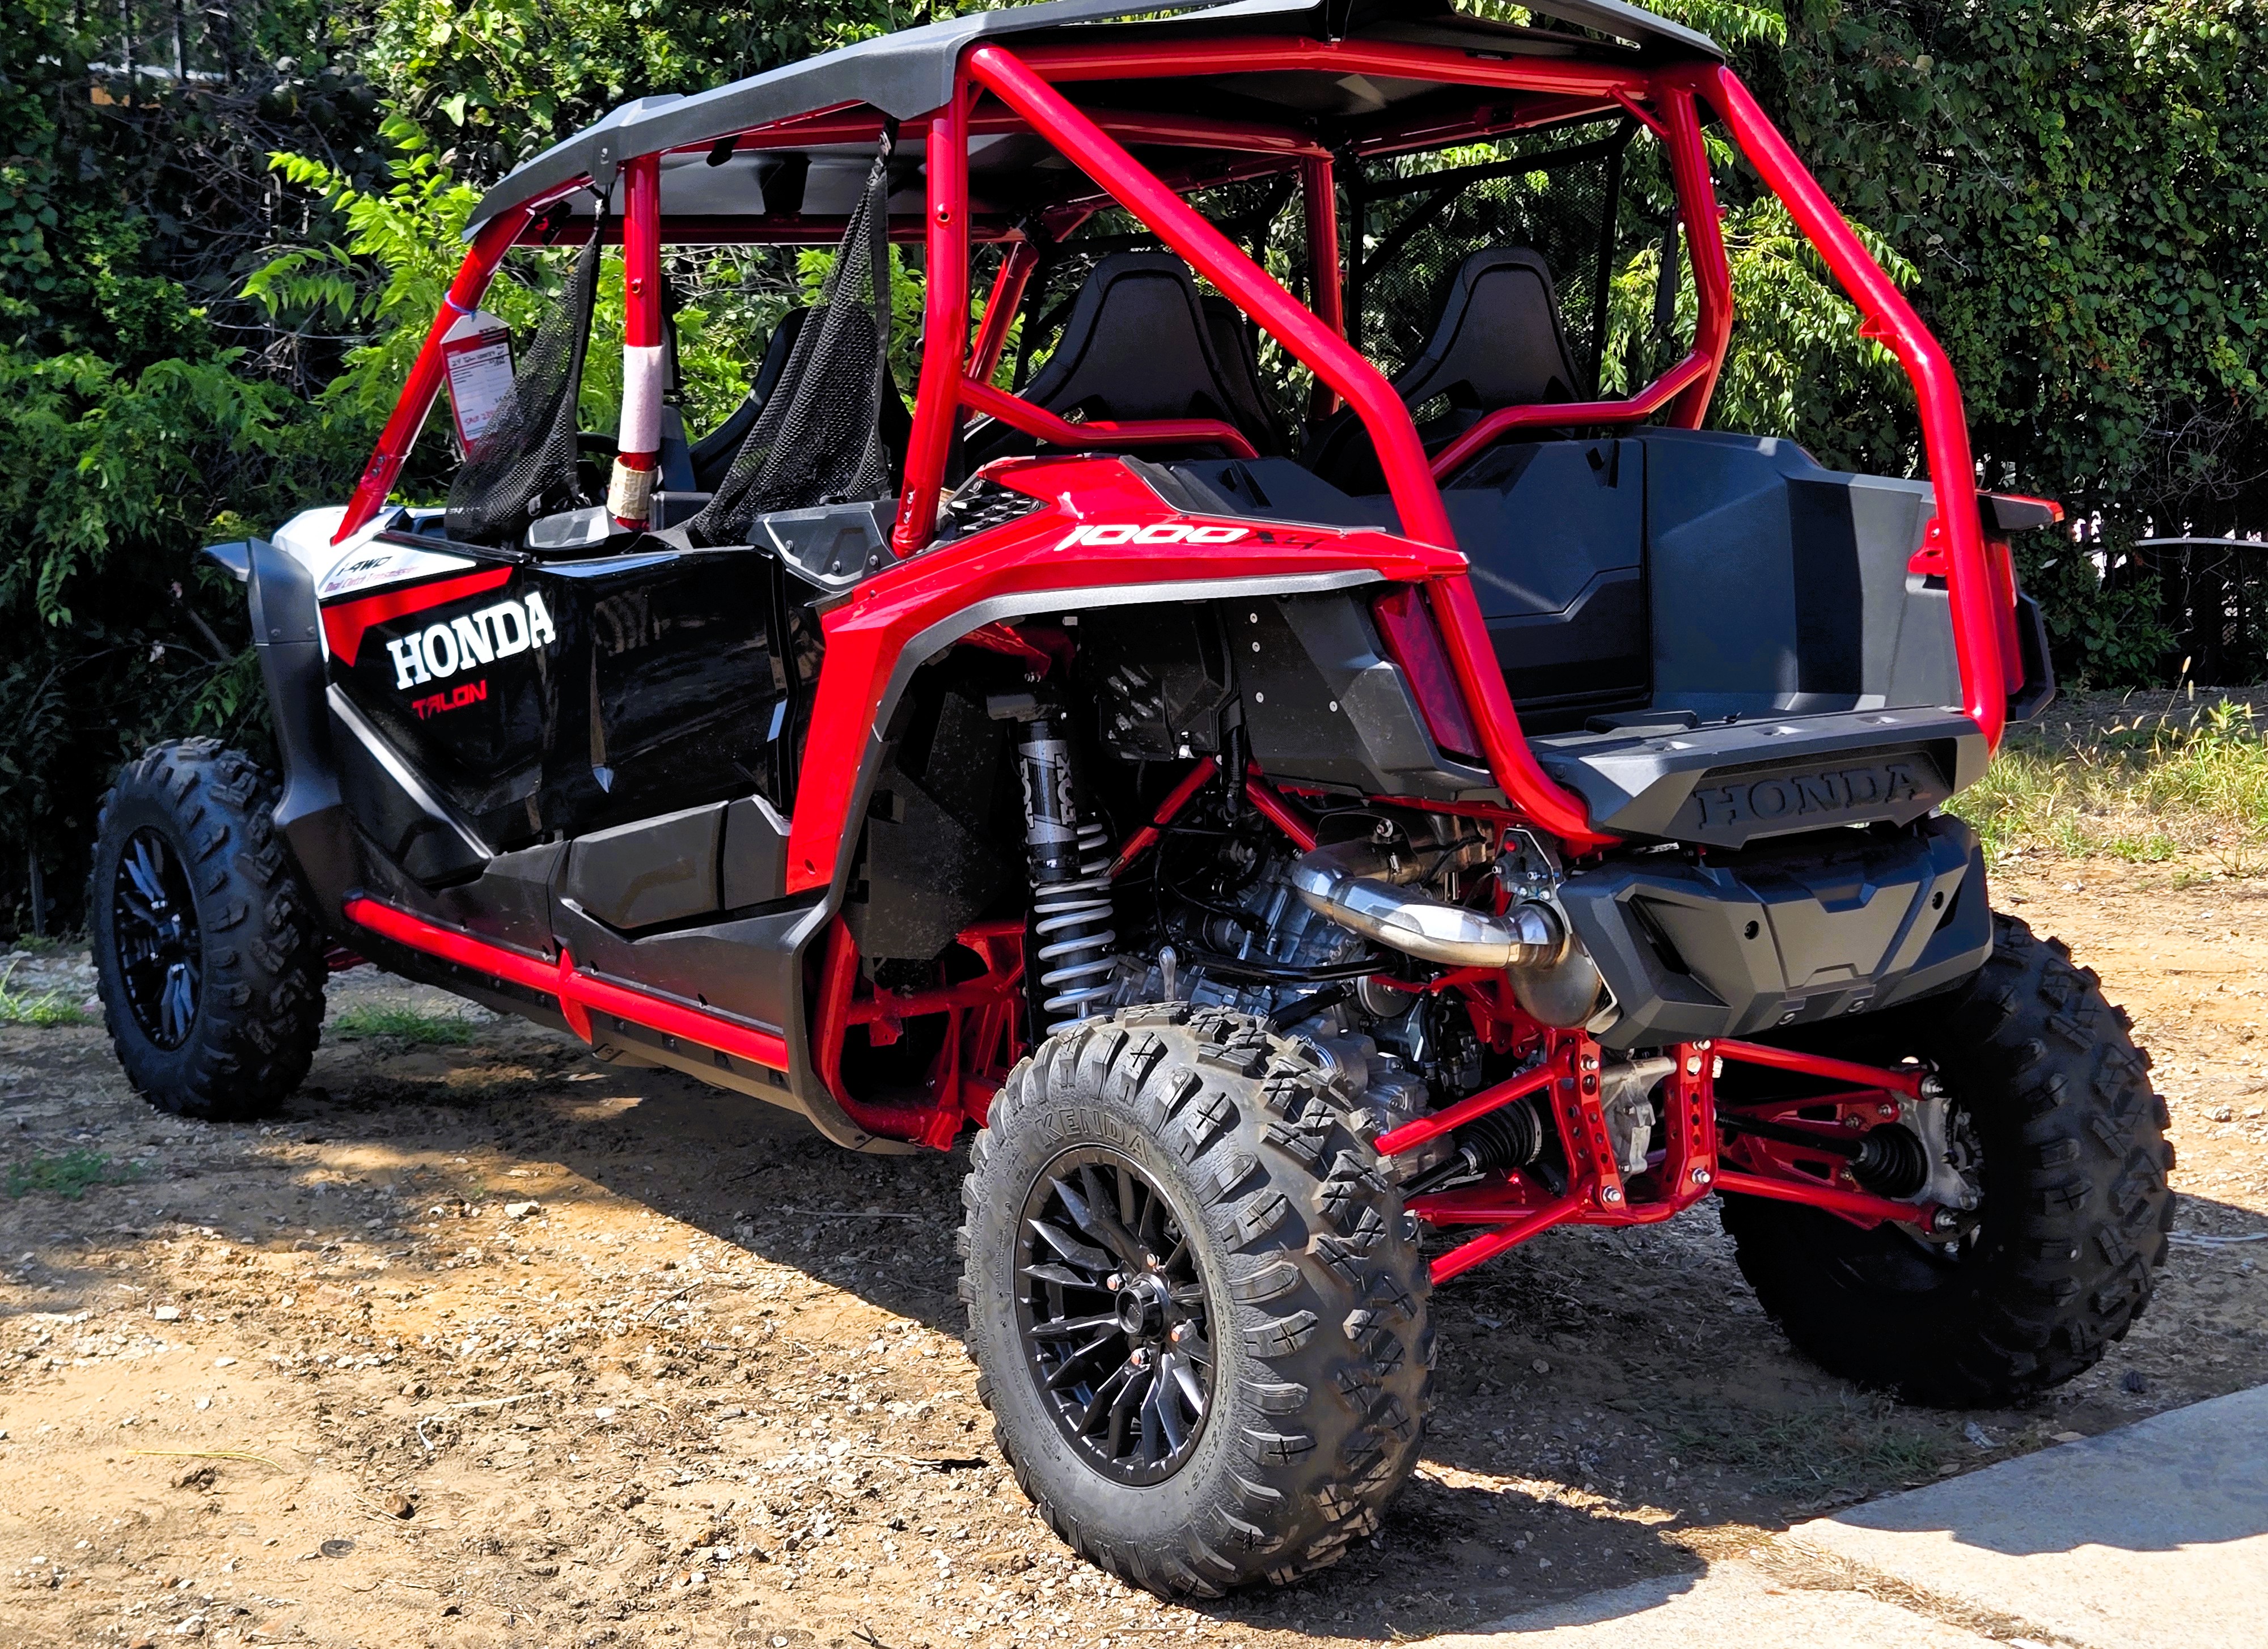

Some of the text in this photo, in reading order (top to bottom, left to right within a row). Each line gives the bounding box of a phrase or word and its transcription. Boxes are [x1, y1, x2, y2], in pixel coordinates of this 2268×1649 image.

[1053, 524, 1250, 552] 1000
[386, 591, 556, 690] HONDA
[412, 680, 488, 720] TALON
[1693, 764, 1923, 830] HONDA
[1034, 1108, 1150, 1165] KENDA
